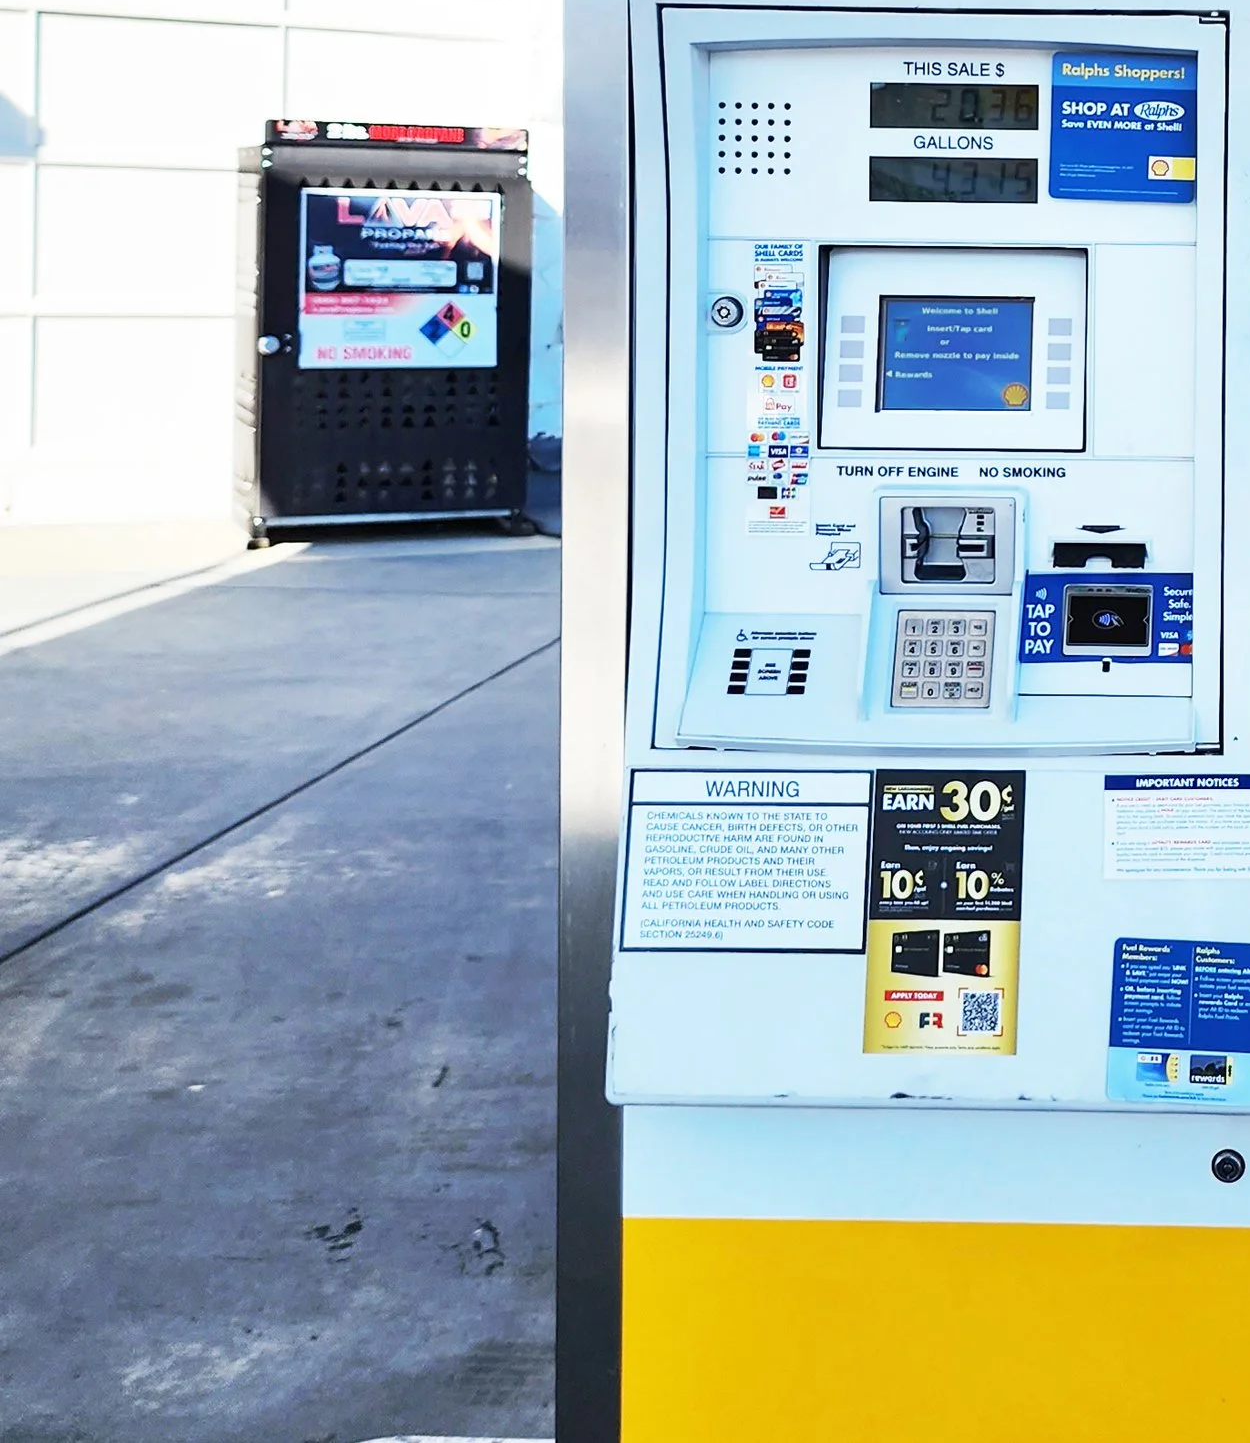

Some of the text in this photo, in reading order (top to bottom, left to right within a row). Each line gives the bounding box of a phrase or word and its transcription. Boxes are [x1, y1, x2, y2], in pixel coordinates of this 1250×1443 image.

[903, 61, 1005, 78] THIS SALE $
[1061, 62, 1185, 82] Ralphs Shoppers!
[1061, 101, 1180, 119] SHOP AT Ralphs
[1061, 119, 1085, 129] Save
[1087, 120, 1112, 129] EVEN
[1113, 120, 1143, 130] MORE
[1144, 122, 1155, 131] at
[913, 135, 994, 150] GALLONS
[921, 306, 998, 315] Welcome to Shell
[973, 325, 993, 333] card
[343, 346, 412, 361] SMOKING
[894, 351, 930, 359] Remove
[932, 351, 961, 359] nozzle
[963, 351, 973, 359] to
[894, 371, 933, 379] Rewards
[836, 465, 959, 478] TURN OFF ENGINE
[979, 466, 1067, 479] NO SMOKING
[1168, 598, 1191, 609] Safe.
[1026, 604, 1055, 619] TAP
[1028, 621, 1051, 637] TO
[1160, 631, 1179, 639] VISA
[1025, 639, 1055, 655] PAY
[705, 780, 800, 798] WARNING
[1135, 777, 1239, 788] IMPORTANT NOTICES
[882, 779, 1013, 822] EARN 30¢
[646, 811, 828, 821] CHEMICALS KNOWN TO THE STATE TO
[880, 861, 901, 869] Earn
[955, 861, 977, 870] Earn
[880, 869, 924, 900] 10¢
[955, 869, 1005, 900] 10%
[913, 992, 938, 1000] TODAY
[1190, 1073, 1226, 1085] rewards
